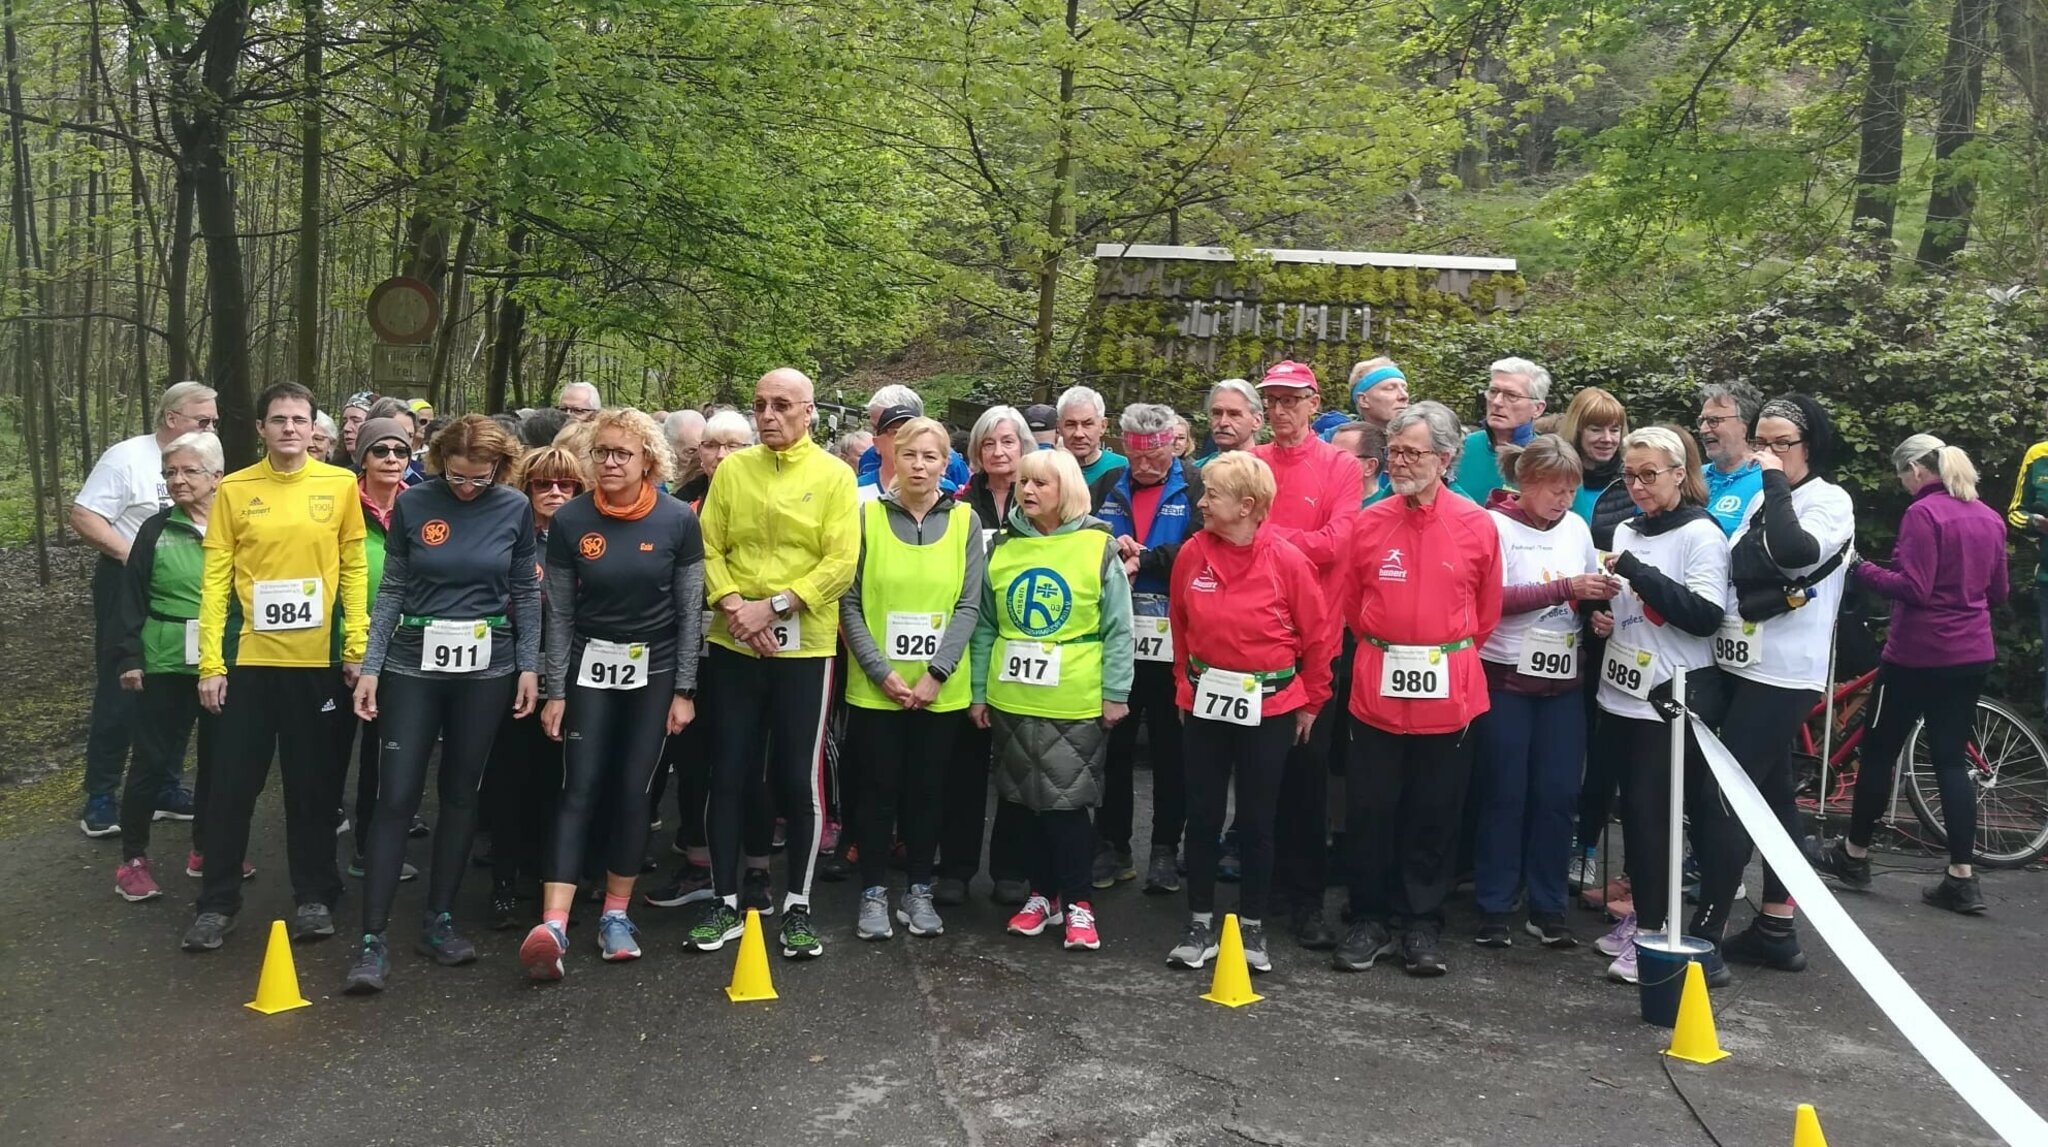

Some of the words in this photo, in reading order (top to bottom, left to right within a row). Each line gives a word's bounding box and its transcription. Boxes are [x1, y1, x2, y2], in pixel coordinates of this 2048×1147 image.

[265, 602, 312, 624] 984
[435, 645, 478, 667] 911
[896, 634, 936, 656] 926
[1133, 636, 1163, 656] 47
[1716, 637, 1749, 663] 988
[591, 662, 636, 685] 912
[1008, 656, 1049, 680] 917
[1531, 651, 1571, 674] 990
[1607, 658, 1642, 690] 989
[1391, 669, 1437, 693] 980
[1205, 692, 1249, 720] 776
